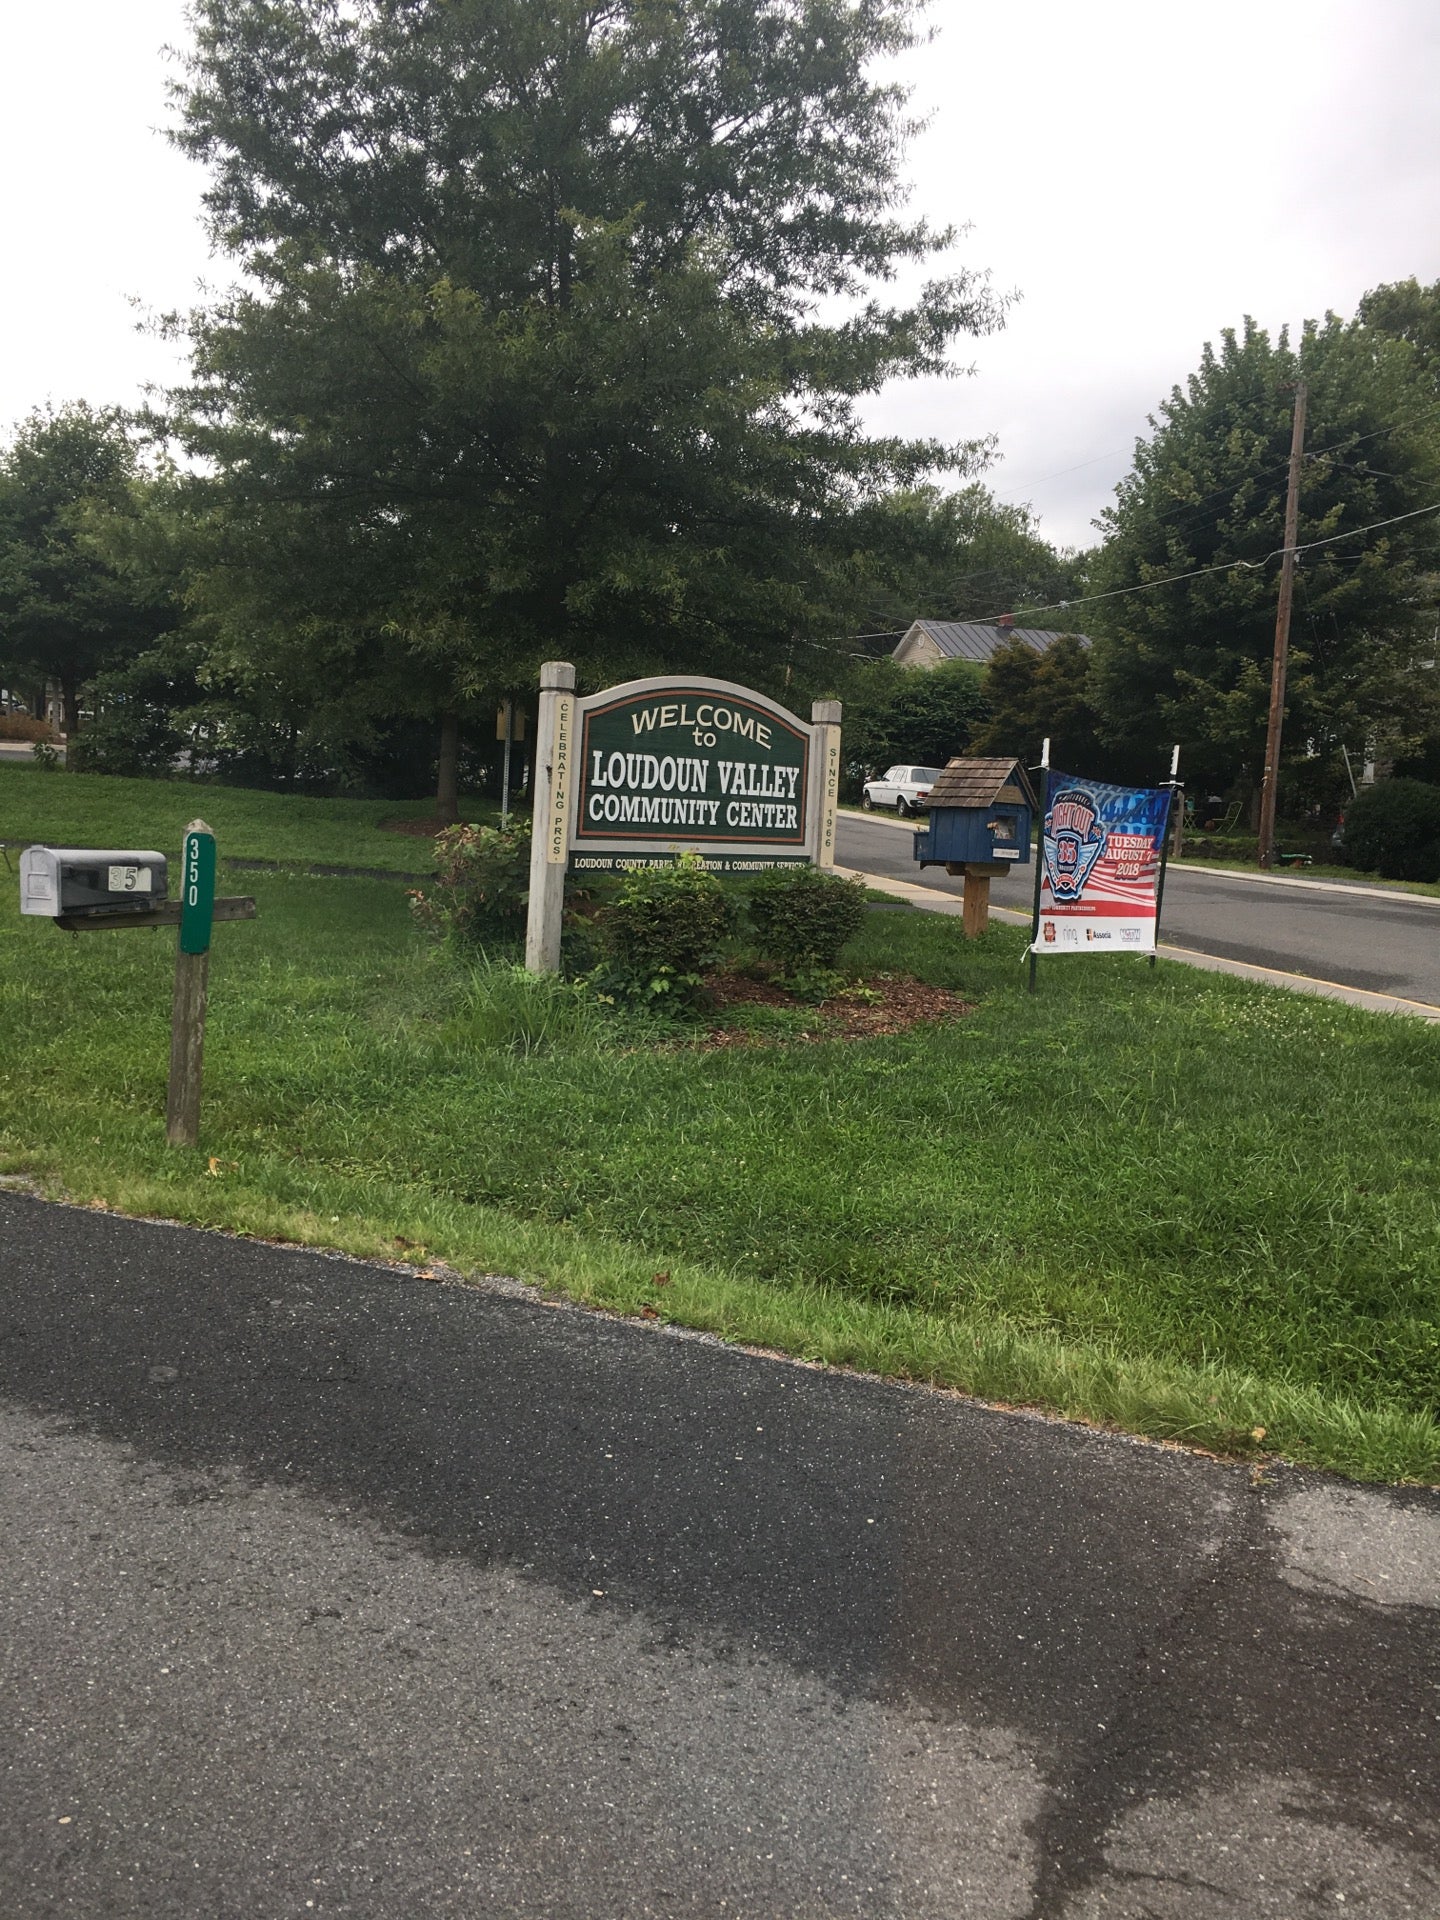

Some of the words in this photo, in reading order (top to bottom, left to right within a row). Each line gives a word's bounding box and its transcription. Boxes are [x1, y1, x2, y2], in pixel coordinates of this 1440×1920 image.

[631, 704, 772, 750] WELCOME
[692, 727, 716, 747] to
[555, 703, 569, 810] CELEBRATING
[591, 750, 709, 793] LOUDOUN
[717, 761, 800, 799] VALLEY
[828, 748, 837, 797] SINCE
[588, 793, 721, 826] COMMUNITY
[726, 801, 798, 829] CENTER
[825, 809, 833, 847] 1966
[1072, 805, 1095, 842] OUT
[552, 817, 563, 855] PRCS
[1058, 840, 1077, 864] 35
[1107, 835, 1154, 849] TUESDAY
[189, 838, 200, 907] 350
[574, 858, 613, 869] LOUDOUN
[615, 859, 647, 870] COUNTY
[677, 860, 723, 871] REREATION
[724, 861, 731, 871] &
[732, 861, 775, 871] COMMUNITY
[1105, 848, 1145, 861] AUGUST
[1146, 851, 1153, 862] 7
[1116, 862, 1140, 876] 2018
[1093, 930, 1112, 939] Associa
